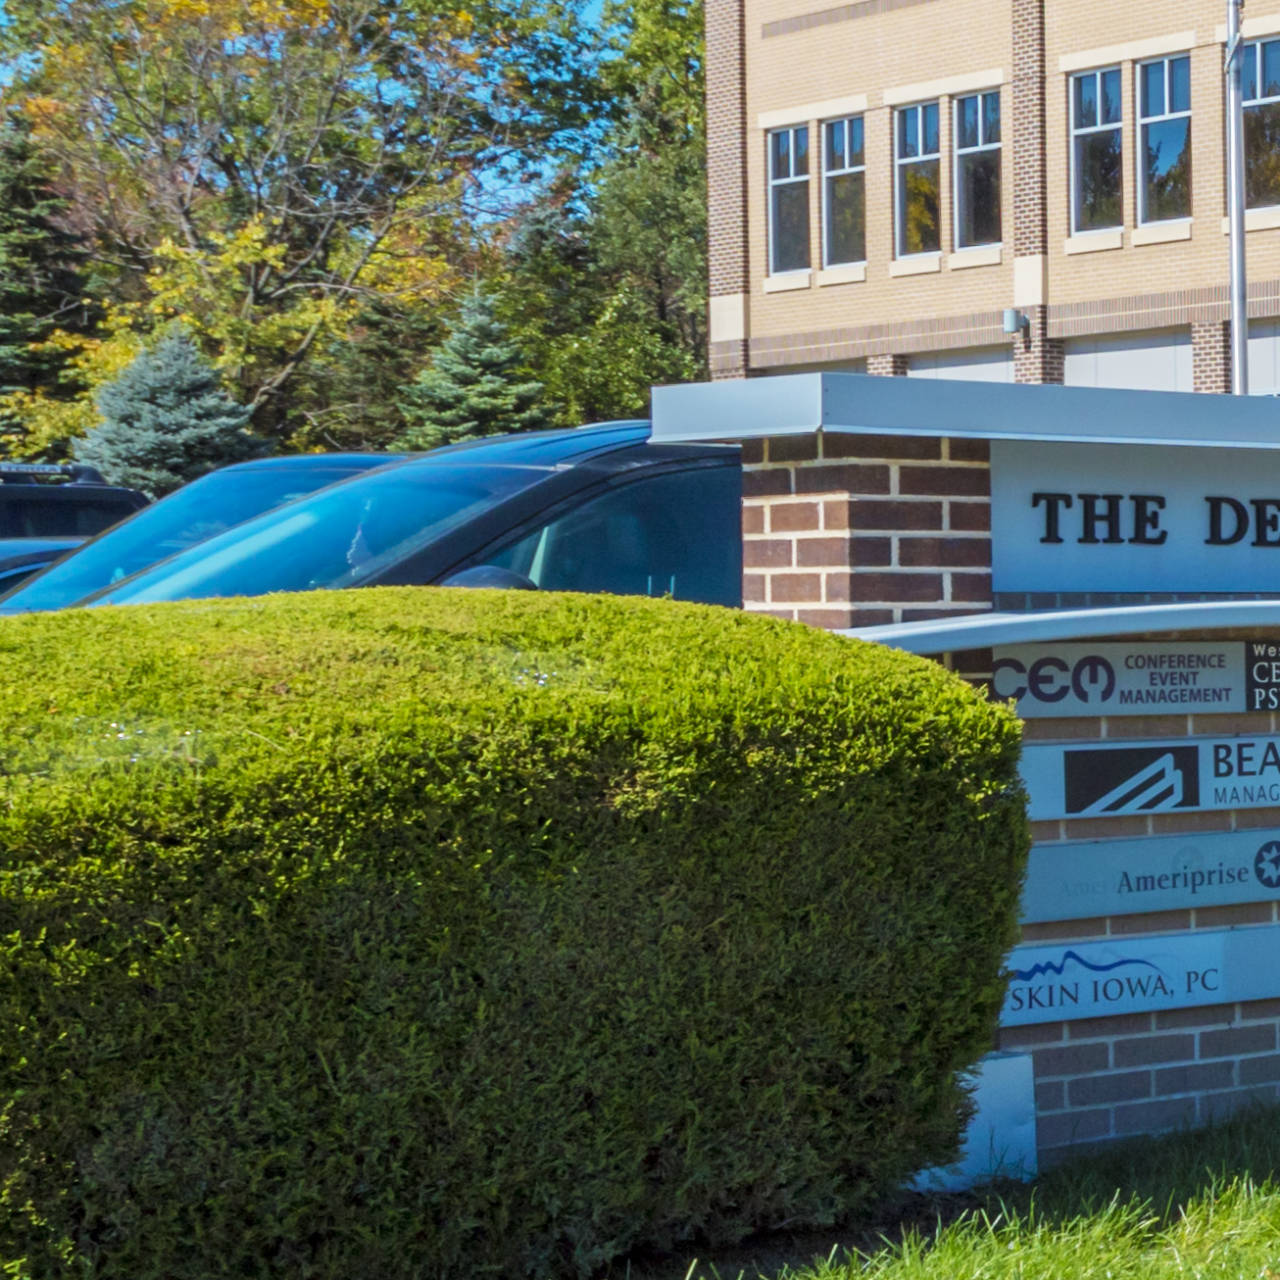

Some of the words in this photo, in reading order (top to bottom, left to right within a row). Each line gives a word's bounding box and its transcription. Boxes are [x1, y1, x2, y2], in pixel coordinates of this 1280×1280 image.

[1031, 492, 1169, 546] THE
[1124, 654, 1227, 669] CONFERENCE
[1149, 671, 1200, 686] EVENT
[1119, 688, 1232, 704] MANAGEMENT
[1116, 861, 1250, 894] Ameriprise
[1010, 982, 1080, 1011] SKIN
[1093, 974, 1175, 1003] IOWA,
[1186, 969, 1219, 993] PC
